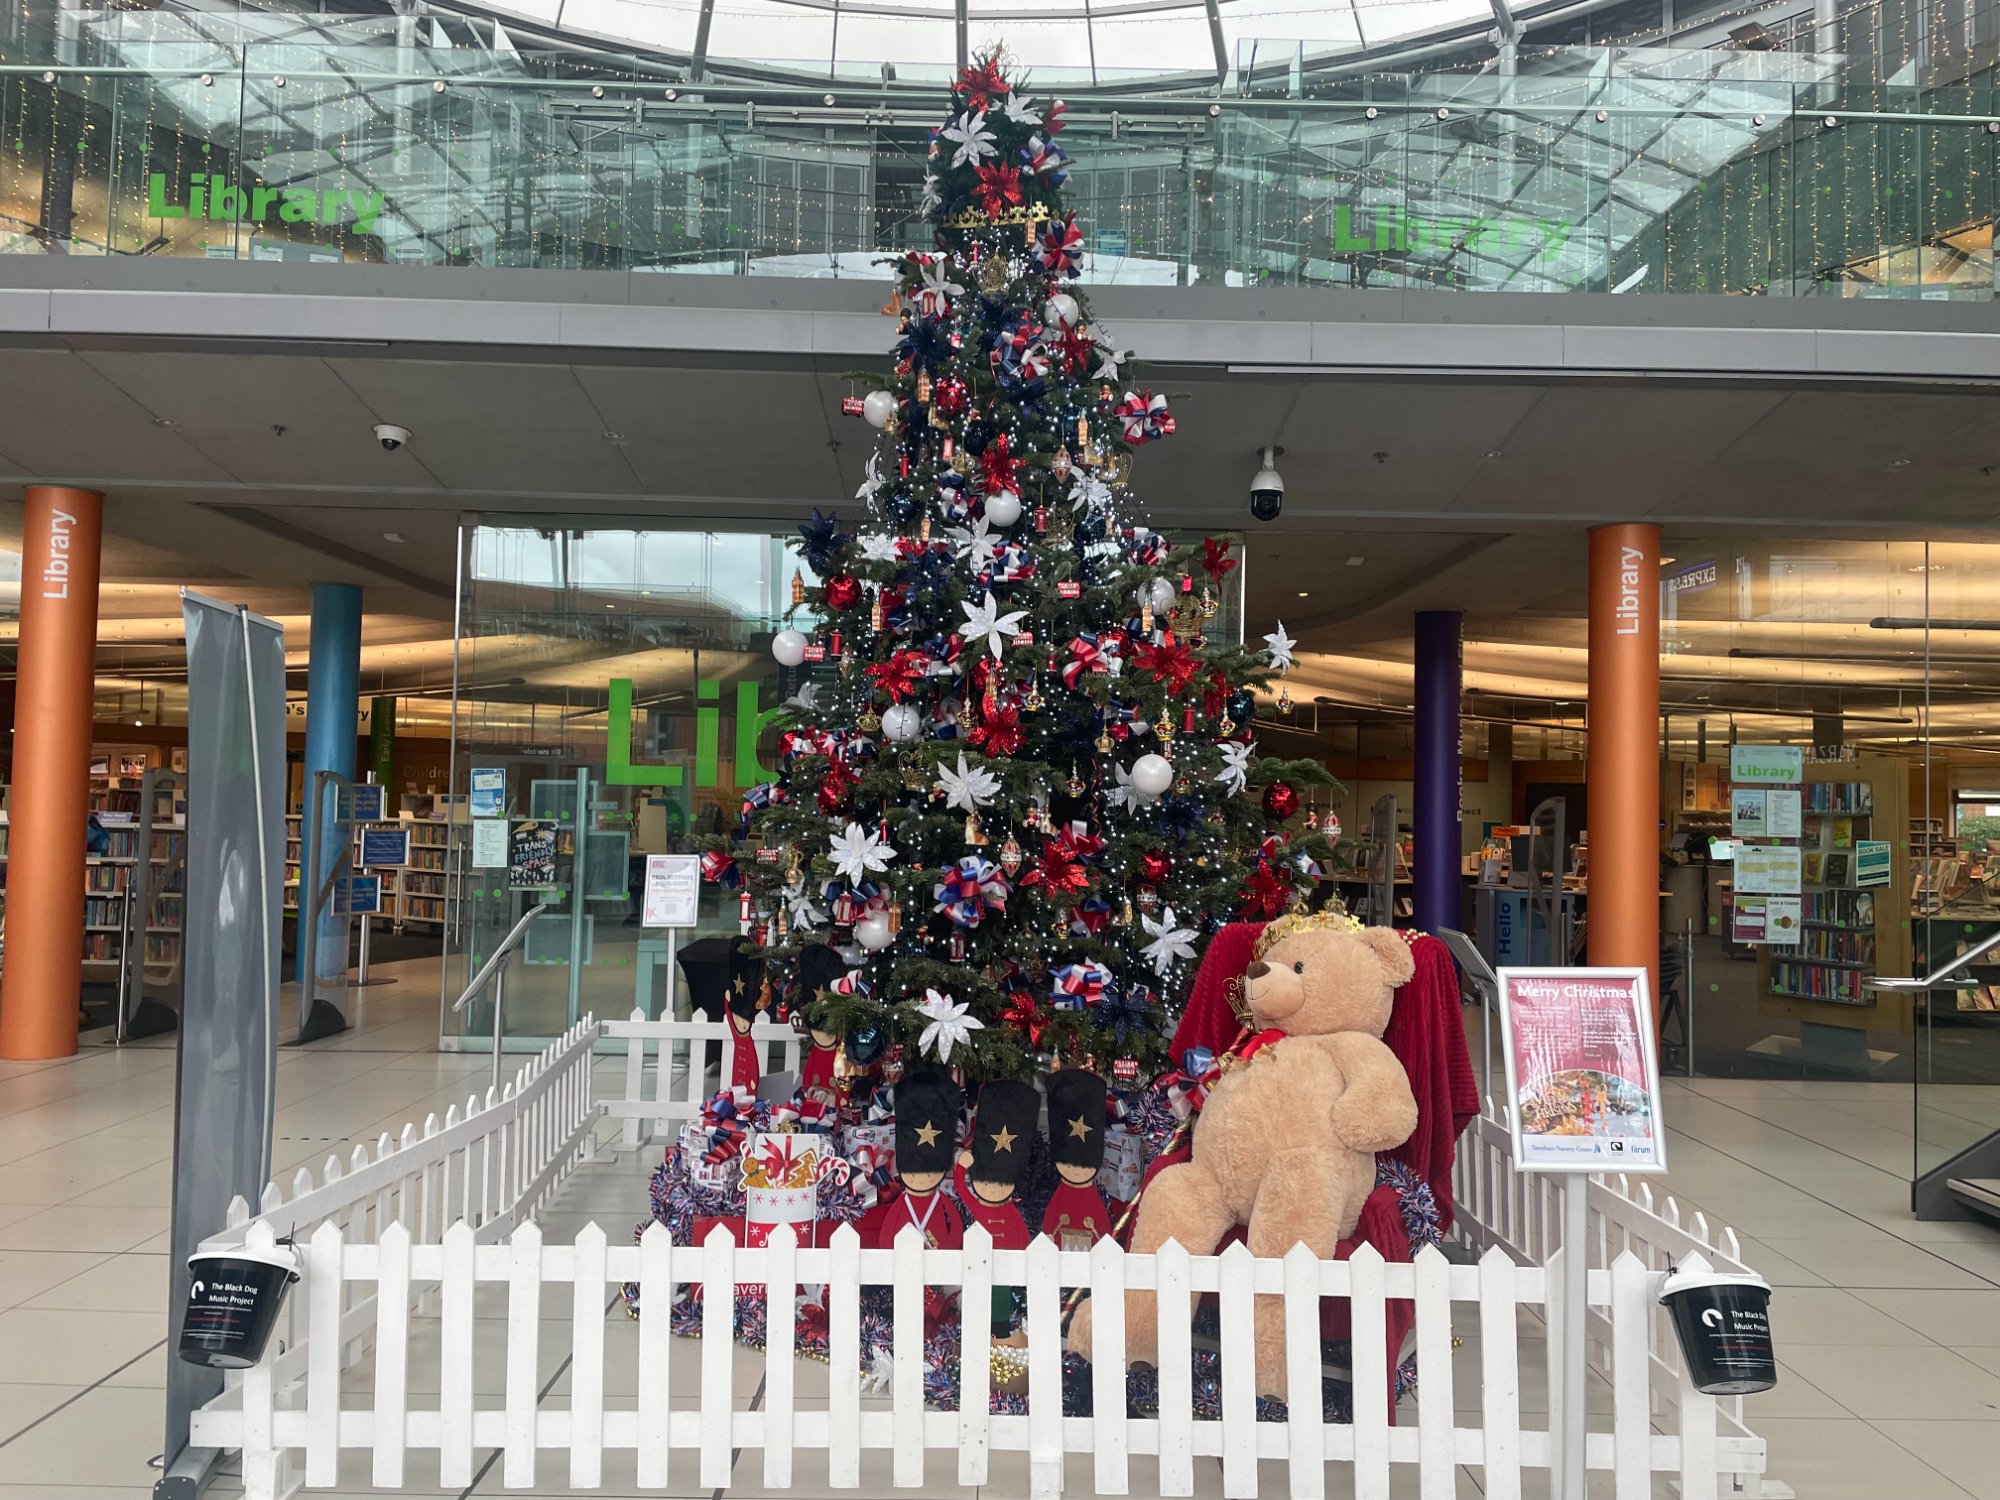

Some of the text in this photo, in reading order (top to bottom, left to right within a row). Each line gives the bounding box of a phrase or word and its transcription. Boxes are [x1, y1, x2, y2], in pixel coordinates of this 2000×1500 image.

[148, 174, 385, 234] Library
[1333, 205, 1573, 262] Library
[43, 508, 77, 600] Library
[1617, 546, 1644, 635] Library
[1737, 764, 1796, 780] Library
[515, 845, 555, 863] FRIENDLY
[516, 840, 546, 853] TRANS
[1875, 845, 1889, 853] SALE
[522, 856, 551, 869] SPACE
[1498, 902, 1511, 955] Hello
[1517, 985, 1635, 1001] Merry Christmas
[211, 1282, 258, 1295] The Black Dog
[208, 1295, 254, 1305] Music Project
[1731, 1310, 1744, 1318] The
[1744, 1311, 1759, 1320] Black
[1734, 1323, 1753, 1331] Music
